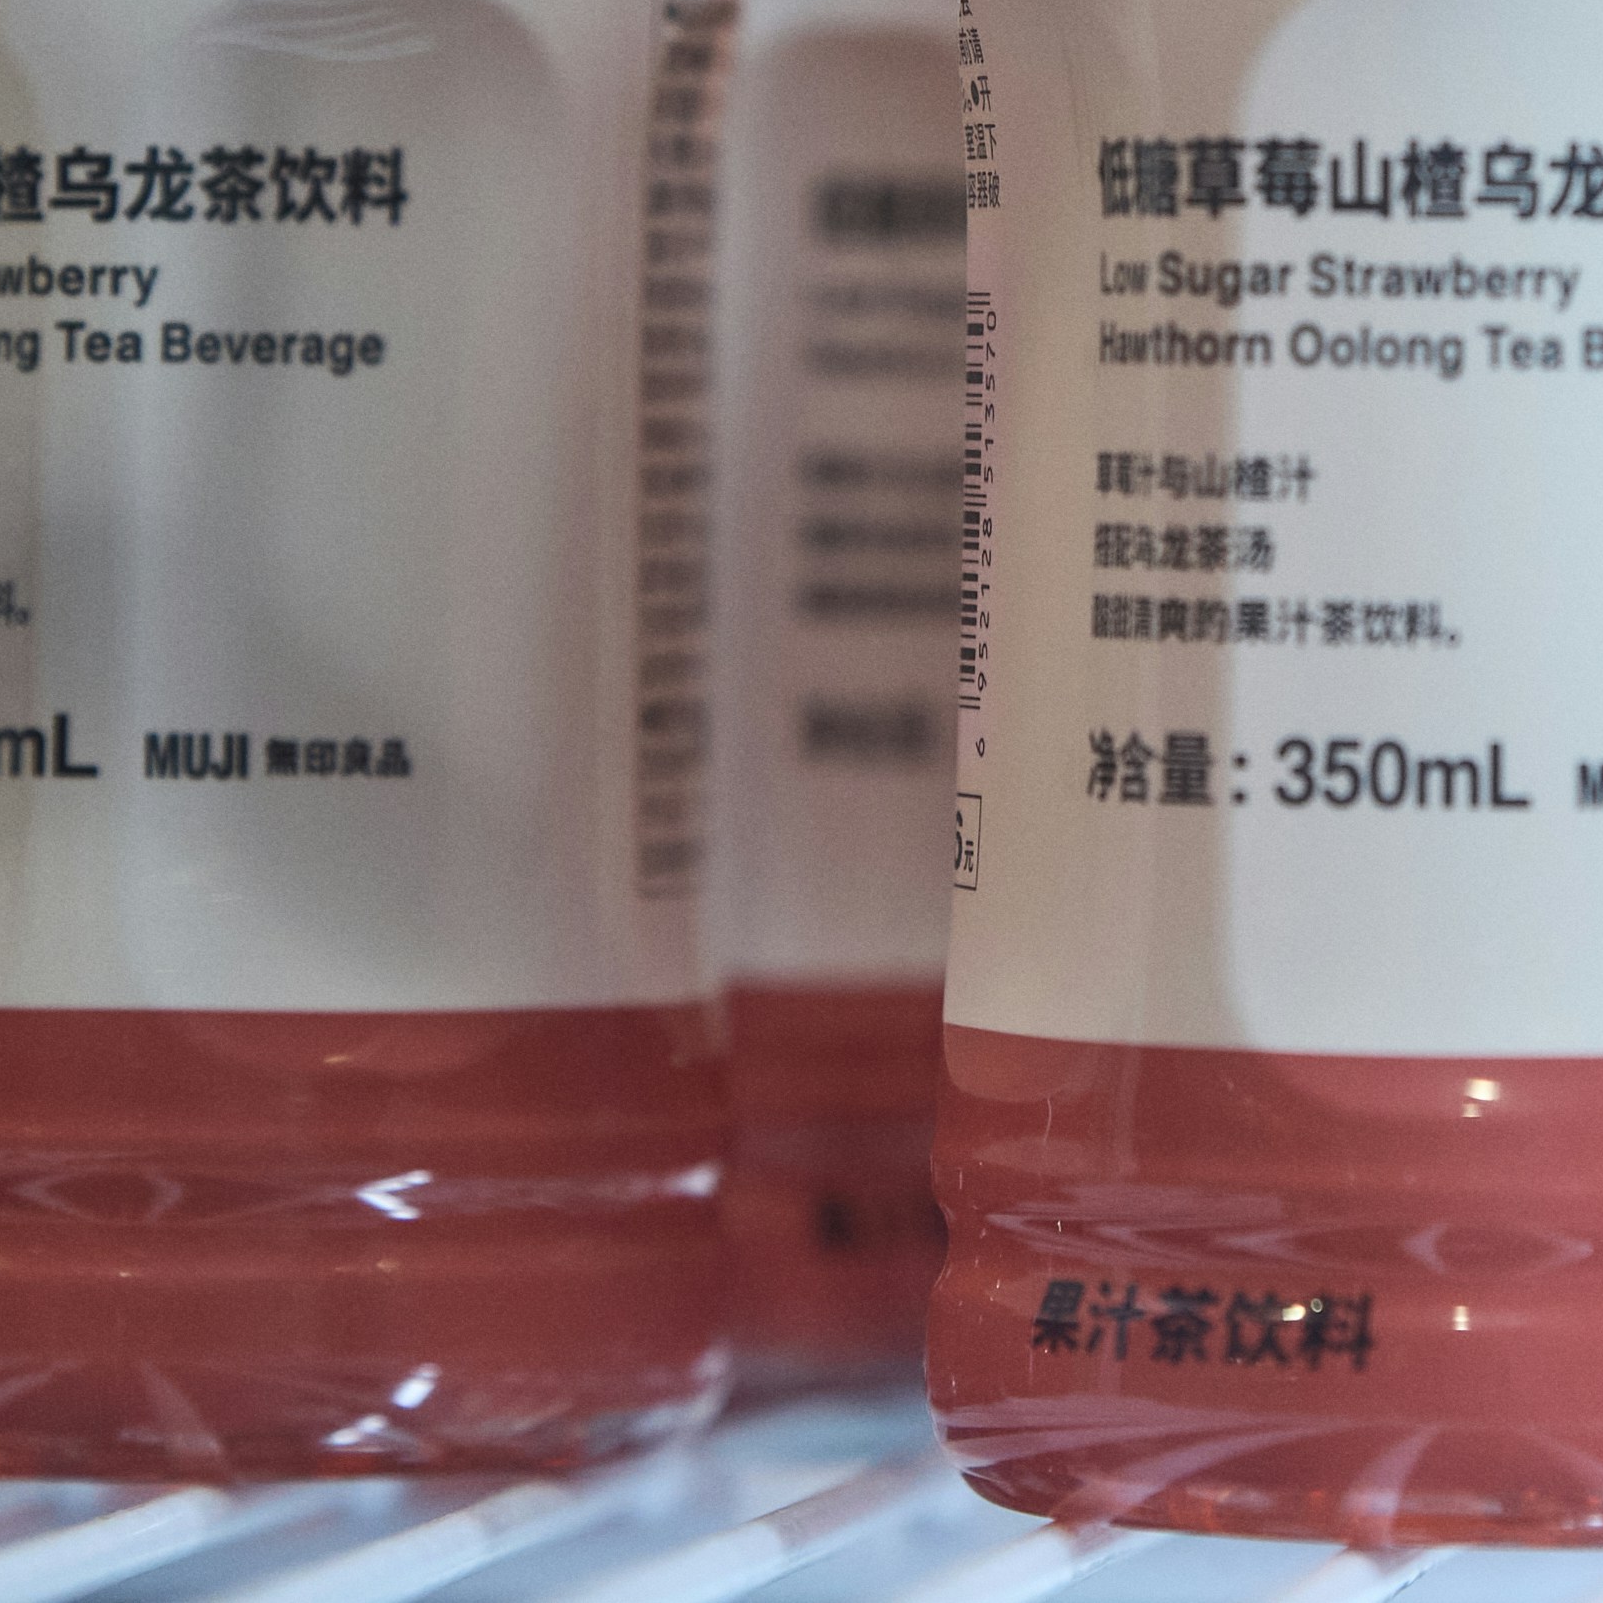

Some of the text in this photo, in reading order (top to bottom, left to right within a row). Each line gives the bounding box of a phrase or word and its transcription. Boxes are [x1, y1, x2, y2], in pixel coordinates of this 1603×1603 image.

[1100, 251, 1580, 309] Low Sugar Strawberry
[57, 321, 143, 364] Tea
[162, 323, 385, 376] Beverage
[1099, 322, 1271, 366] Hawthorn
[1289, 324, 1463, 379] Oolong
[1482, 326, 1563, 369] Tea
[145, 733, 250, 780] MUJI
[266, 736, 411, 780] 無印良品
[1032, 1279, 1374, 1372] 果汁茶饮料
